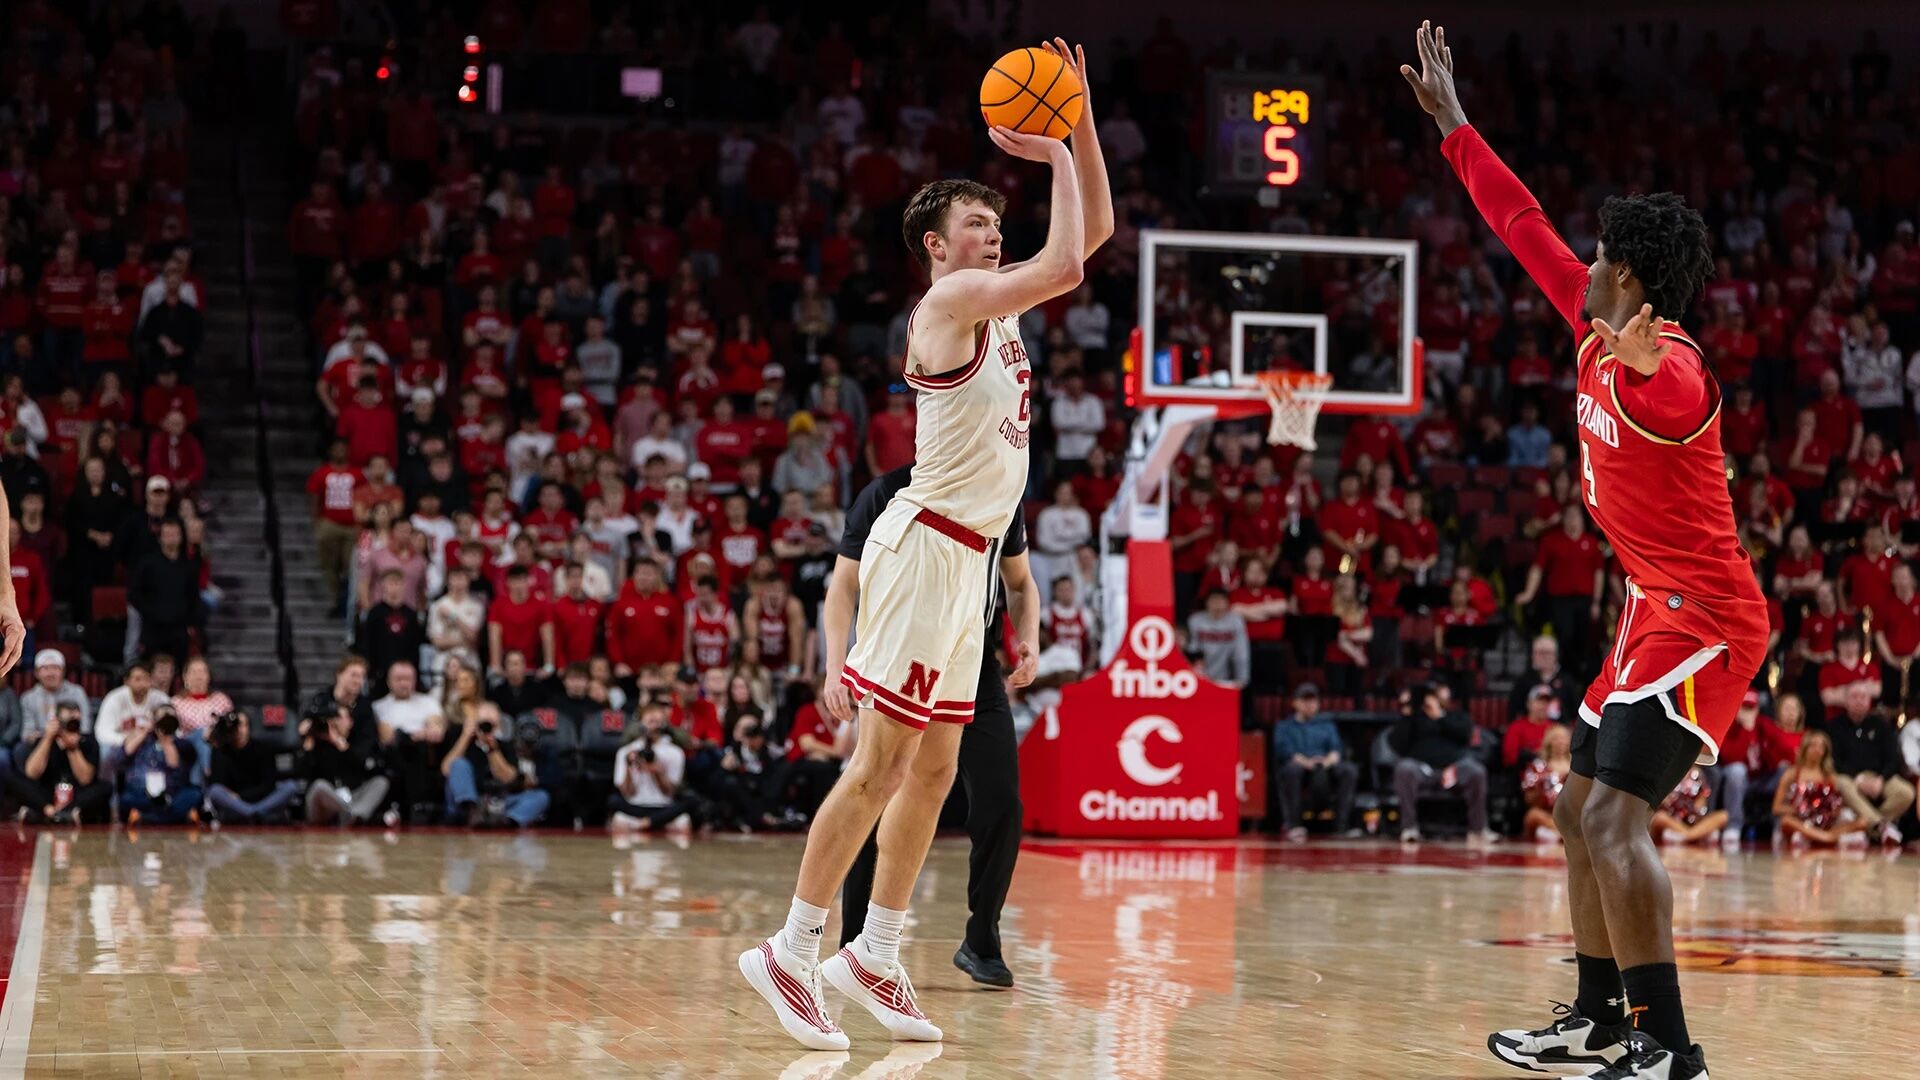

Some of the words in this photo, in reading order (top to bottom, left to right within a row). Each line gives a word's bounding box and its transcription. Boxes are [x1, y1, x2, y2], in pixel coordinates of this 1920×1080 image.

[1253, 89, 1309, 124] 1:29
[1264, 125, 1299, 185] 5
[899, 659, 941, 703] N
[1109, 659, 1198, 699] fnbo
